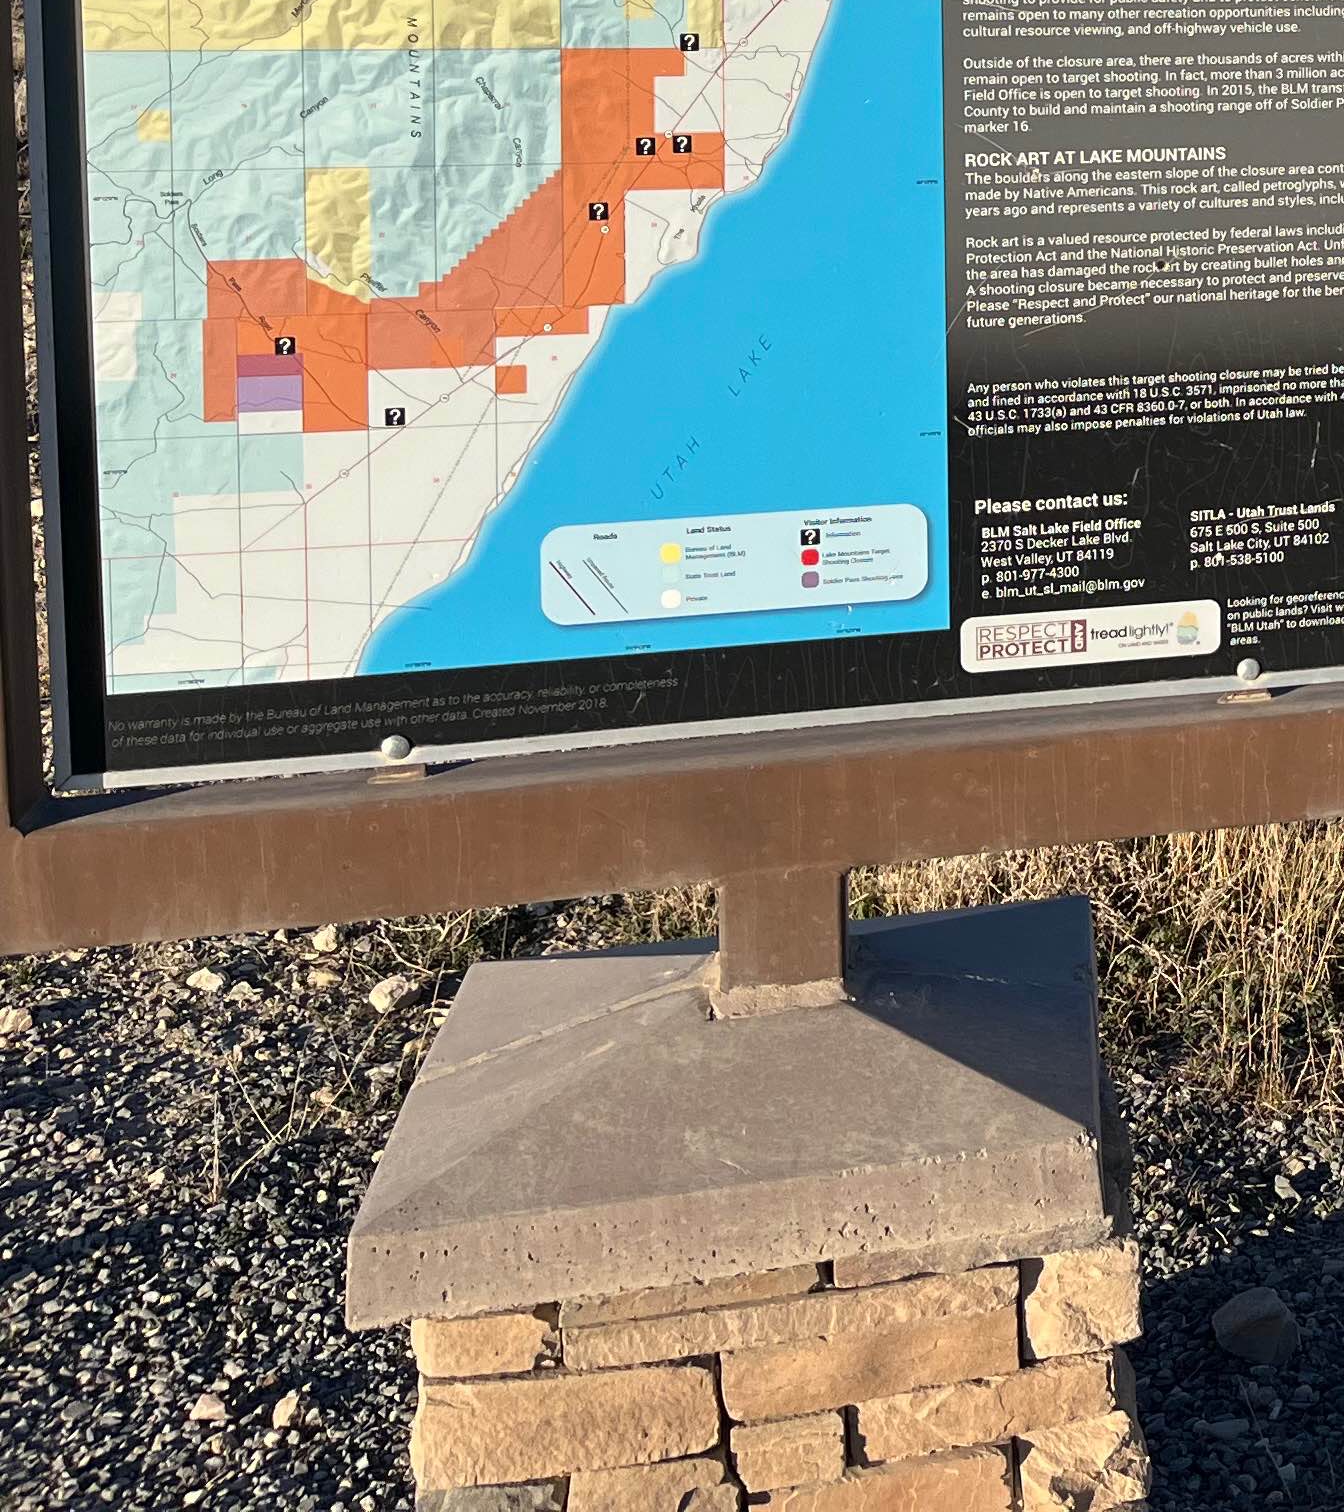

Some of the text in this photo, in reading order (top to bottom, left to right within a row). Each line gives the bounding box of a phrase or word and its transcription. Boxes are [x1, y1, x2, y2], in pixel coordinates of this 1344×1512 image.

[964, 146, 1227, 168] ROCK ART AT LAKE MOUNTAINS
[651, 334, 772, 500] UTAH LAKE
[974, 493, 1128, 515] Please contact us:
[1190, 509, 1227, 523] SITLA
[1236, 507, 1264, 519] Utah
[1267, 504, 1297, 517] Trust
[1300, 501, 1335, 515] Lands
[981, 518, 1142, 538] BLM Salt Lake Field Office
[981, 540, 1012, 552] 2370
[1015, 539, 1023, 550] S
[1027, 537, 1068, 550] Decker
[1072, 535, 1100, 547] Lake
[1190, 540, 1213, 554] Salt
[1217, 539, 1244, 551] Lake
[1273, 535, 1291, 548] UT
[1293, 533, 1330, 546] 84102
[981, 556, 1012, 568] West
[1056, 551, 1073, 563] UT
[1076, 548, 1115, 562] 84119
[979, 622, 1067, 643] RESPECT
[979, 639, 1068, 659] PROTECT
